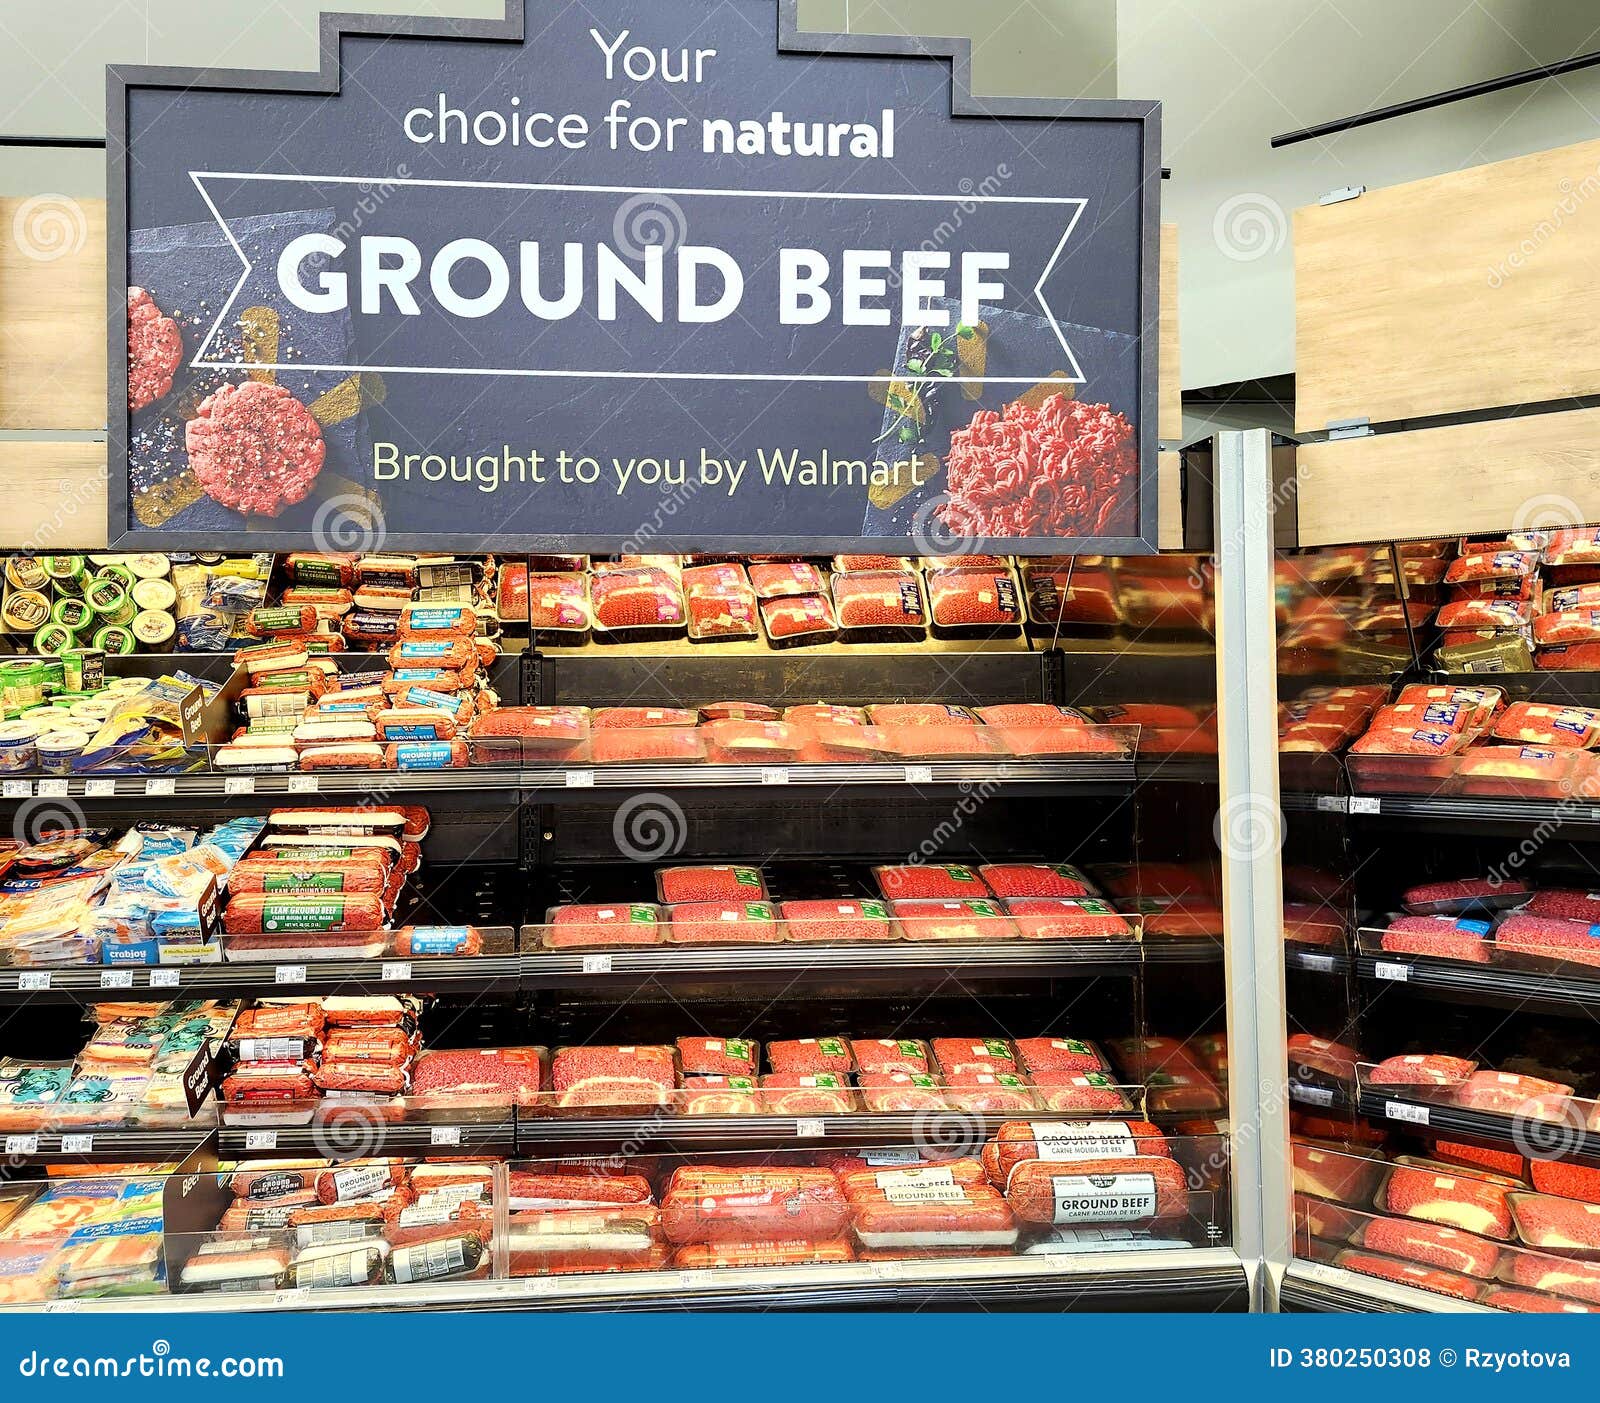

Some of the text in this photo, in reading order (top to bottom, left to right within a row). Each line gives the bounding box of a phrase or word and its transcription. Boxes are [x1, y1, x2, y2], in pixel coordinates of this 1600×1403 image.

[590, 28, 716, 83] Your
[403, 93, 894, 158] choice for natural
[277, 235, 1010, 327] GROUND BEEF
[374, 443, 925, 495] Brought to you by Walmart
[184, 694, 203, 720] Ground
[190, 713, 202, 733] Beef
[291, 906, 320, 914] GROUND
[321, 906, 337, 914] BEEF
[109, 950, 147, 960] crabjoy
[188, 1051, 209, 1089] Ground
[195, 1071, 209, 1099] Beef
[1042, 1135, 1127, 1146] GROUND BEEF
[183, 1162, 201, 1198] Beef
[262, 1178, 290, 1187] GROUND
[339, 1170, 386, 1189] GROUND BEEF
[890, 1191, 936, 1199] GROUND
[1062, 1197, 1150, 1210] GROUND BEEF
